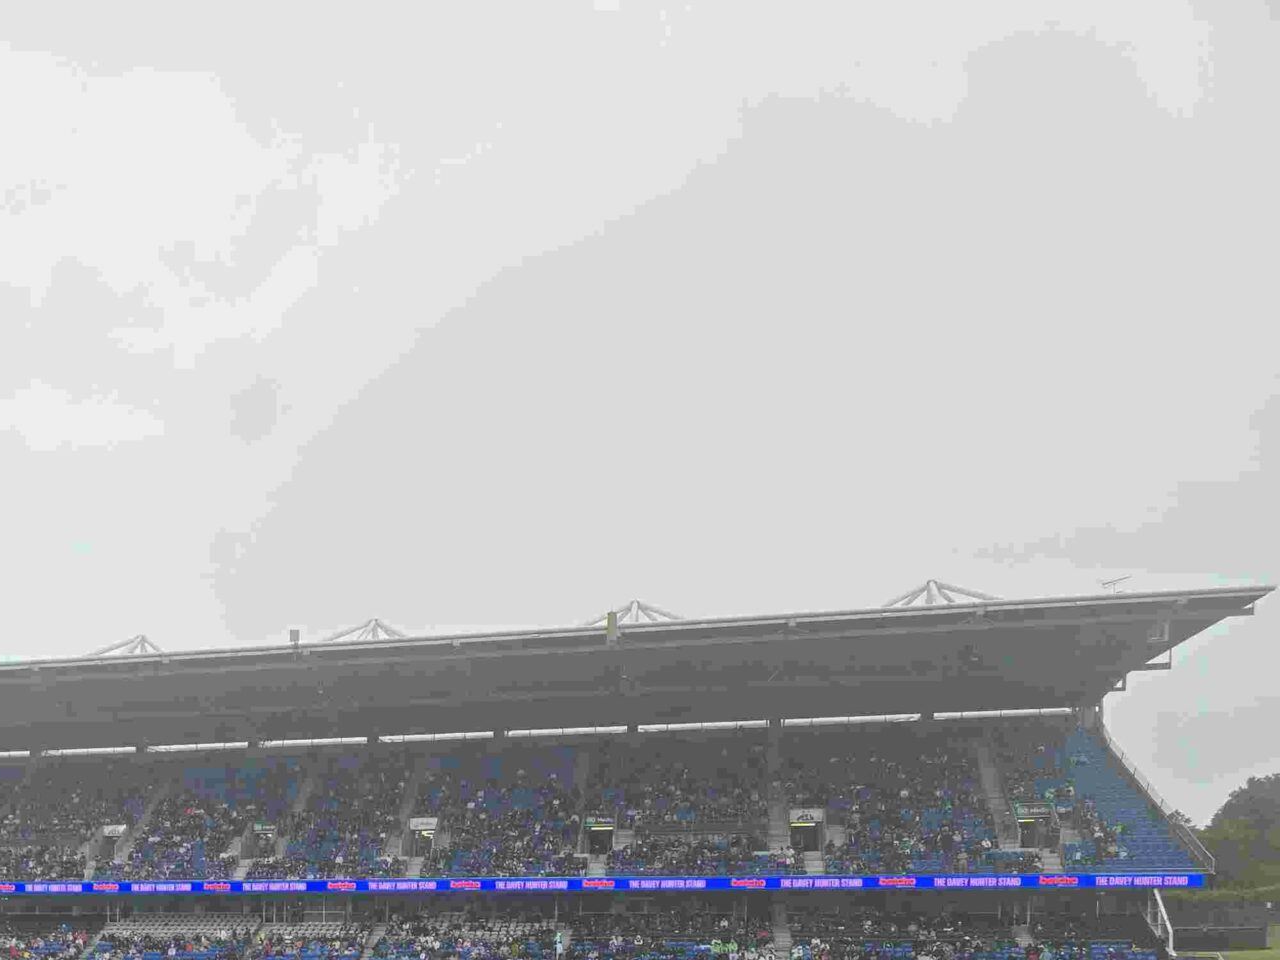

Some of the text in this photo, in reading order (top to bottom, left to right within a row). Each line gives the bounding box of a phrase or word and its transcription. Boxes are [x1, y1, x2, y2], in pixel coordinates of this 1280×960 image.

[934, 878, 946, 886] THE
[998, 878, 1021, 886] STAND
[1096, 876, 1108, 886] THE
[1109, 876, 1132, 886] DAVEY
[1164, 876, 1188, 886] STAND
